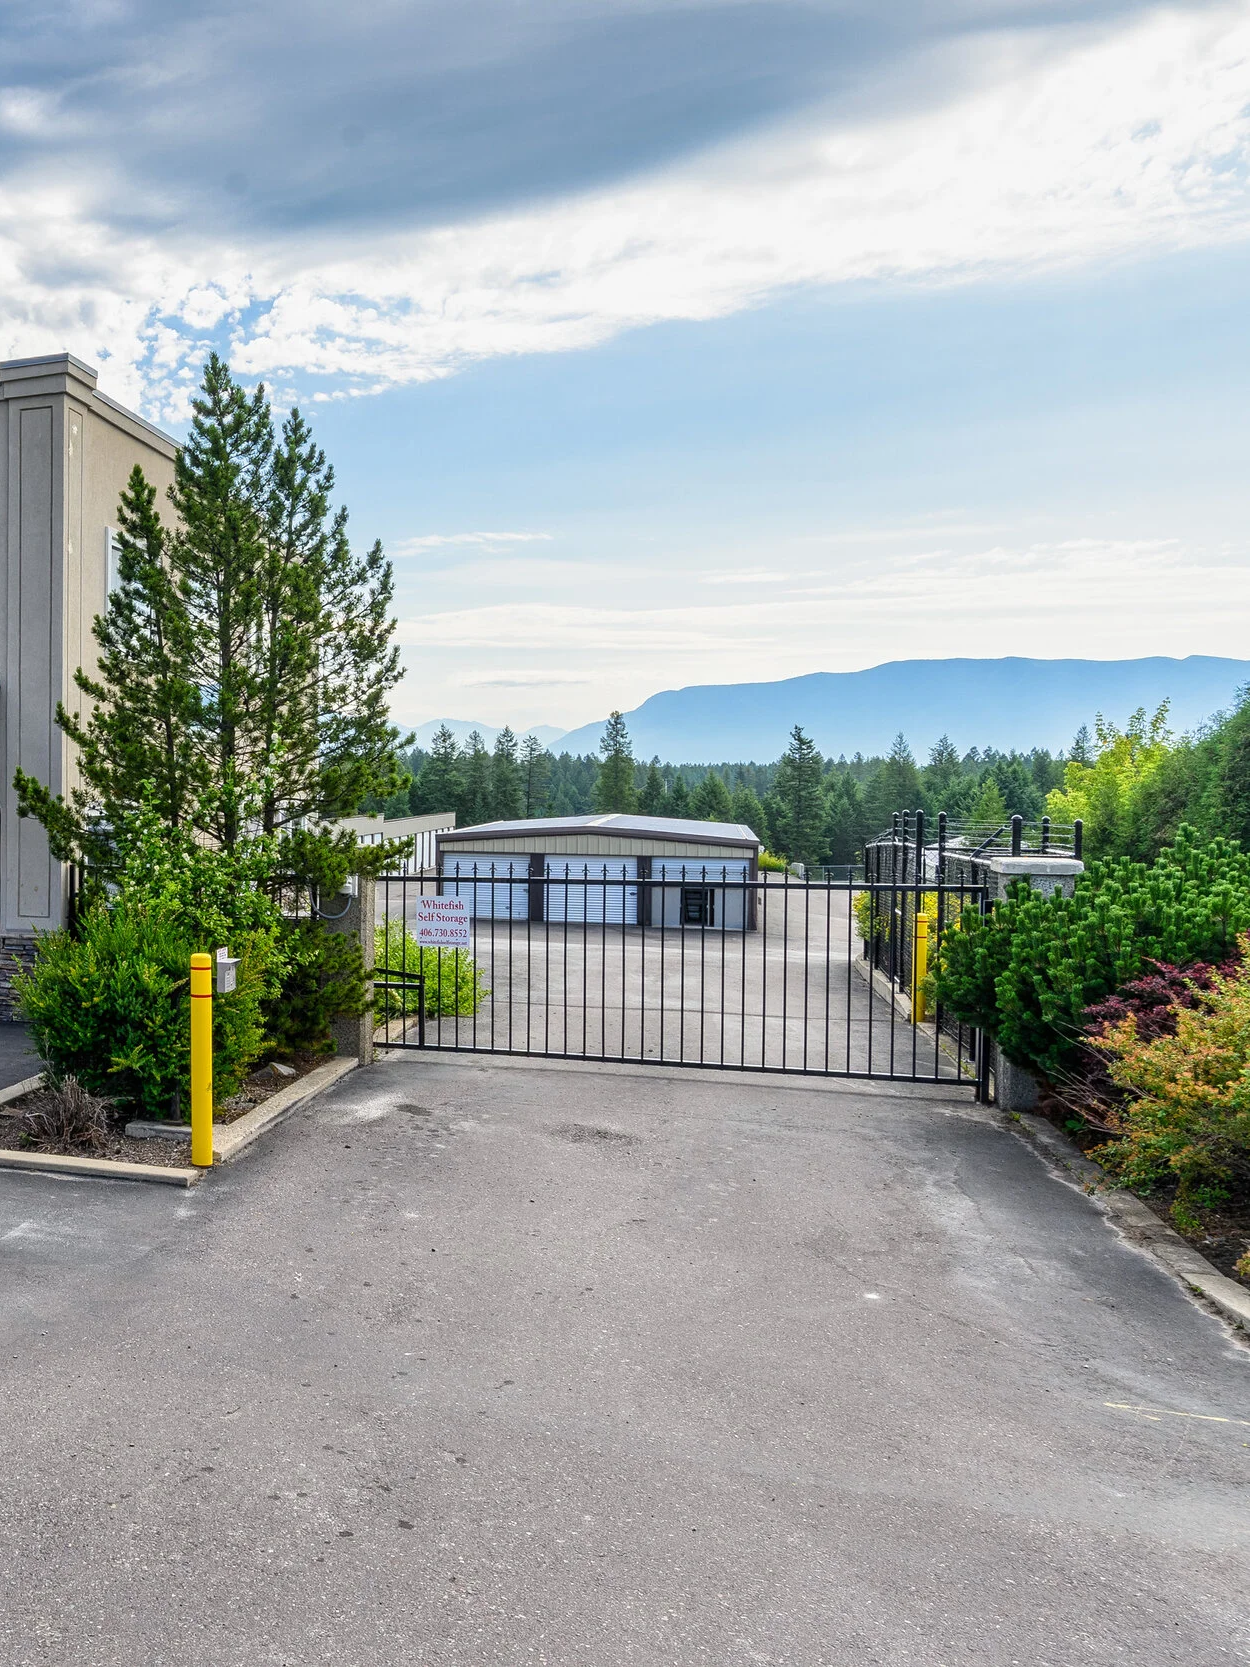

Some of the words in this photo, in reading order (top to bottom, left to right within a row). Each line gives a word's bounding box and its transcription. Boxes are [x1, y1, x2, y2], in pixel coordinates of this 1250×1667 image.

[421, 900, 464, 910] Whitefish
[418, 911, 435, 921] Self
[436, 912, 468, 925] Storage
[419, 928, 467, 938] 406.730.8552
